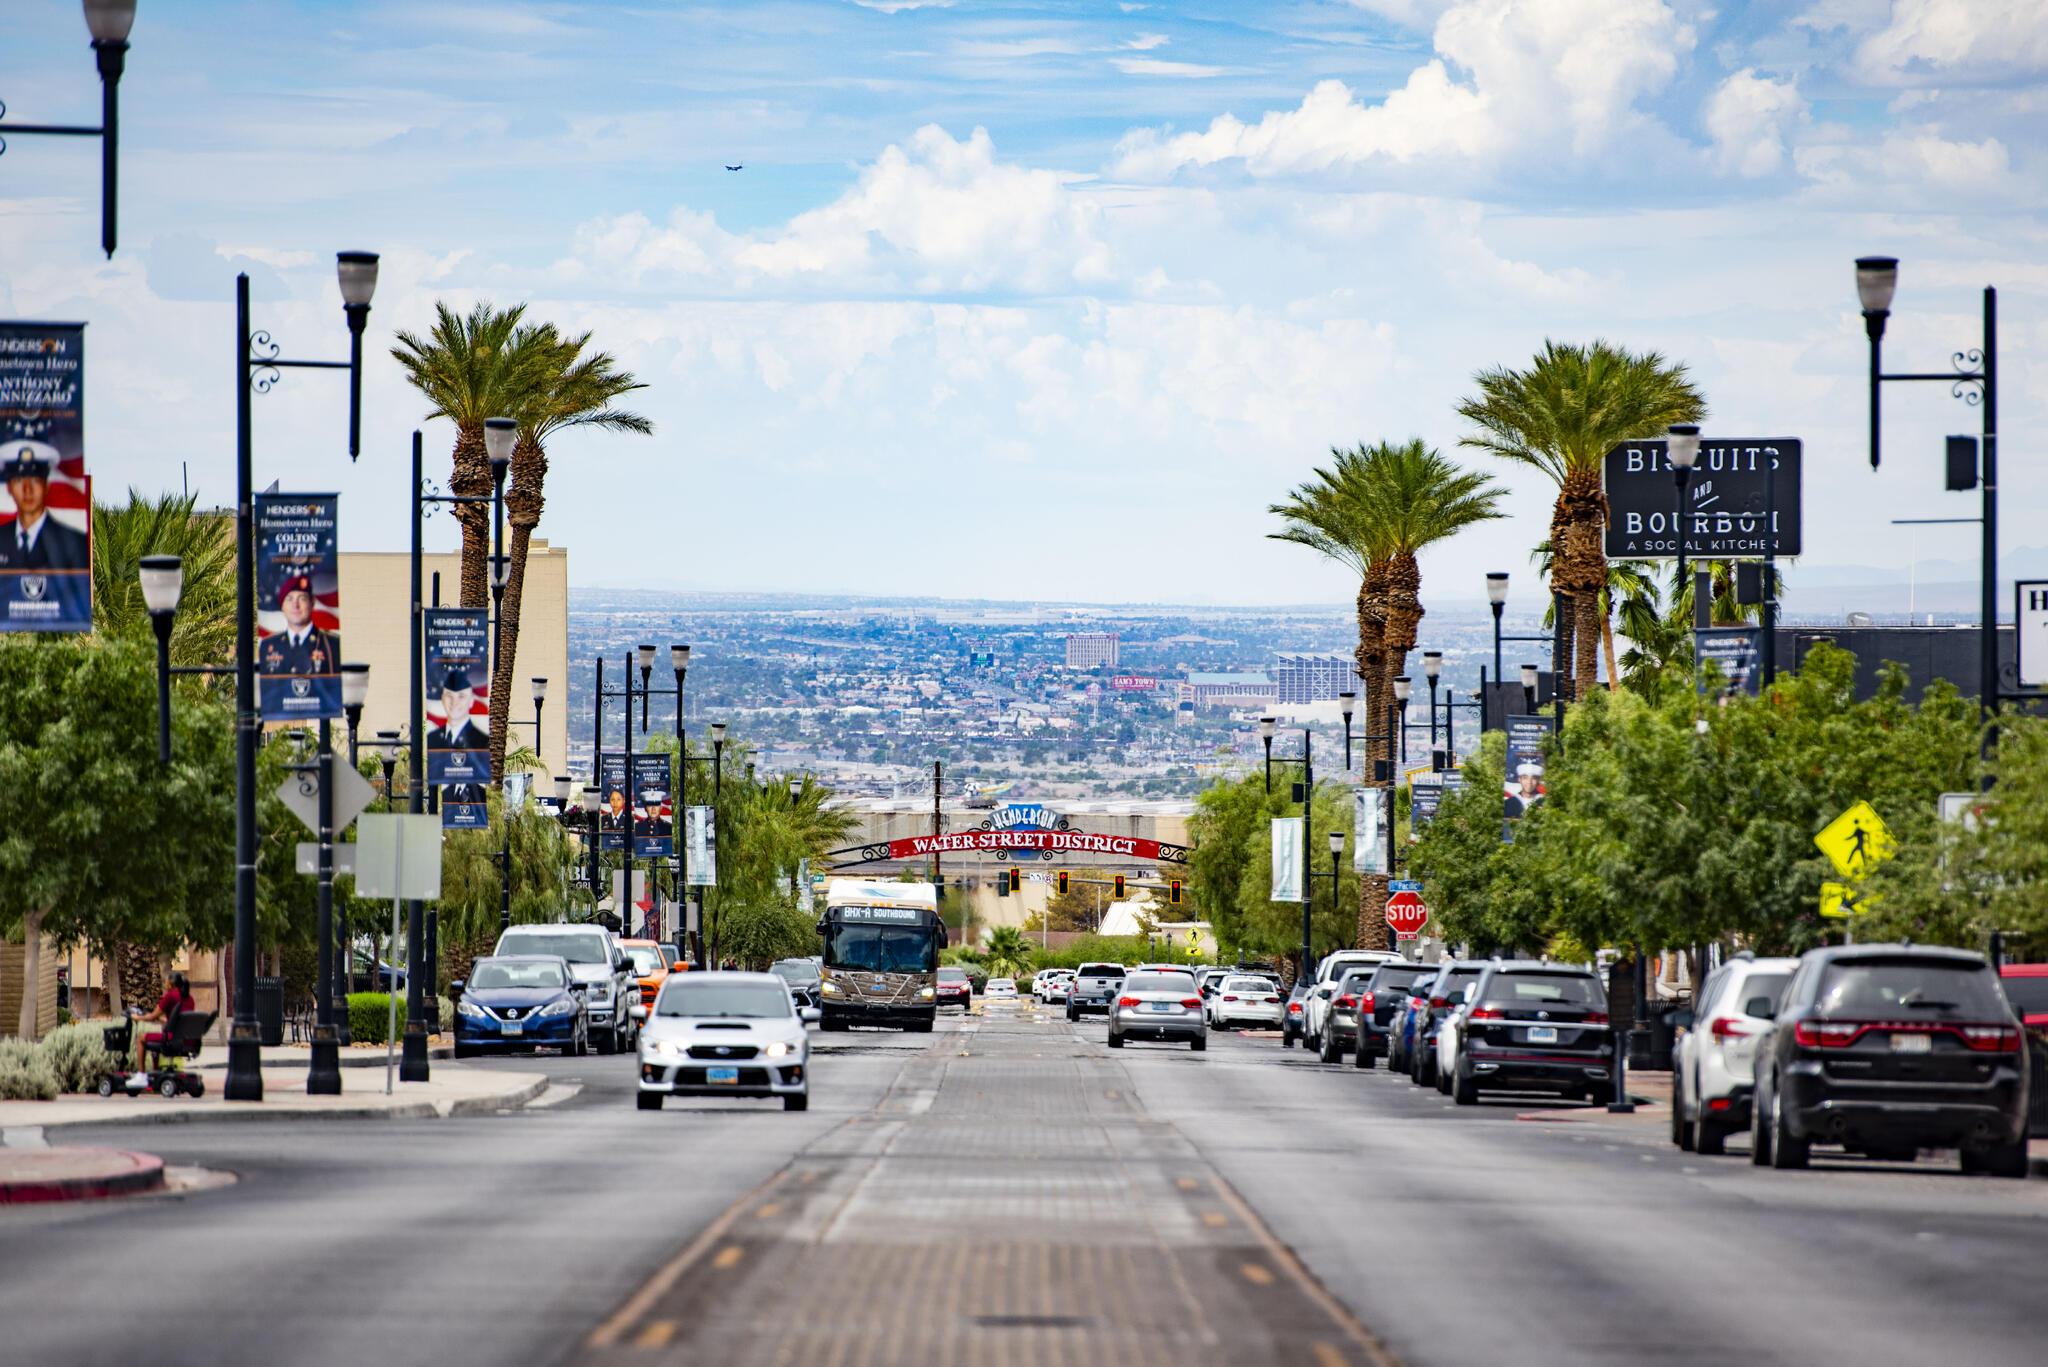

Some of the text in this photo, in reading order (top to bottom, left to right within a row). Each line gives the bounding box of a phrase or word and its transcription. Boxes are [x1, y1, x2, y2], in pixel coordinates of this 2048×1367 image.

[0, 338, 66, 352] NDERSON
[0, 356, 78, 369] metown Hero
[0, 377, 63, 390] NTHONY
[0, 391, 72, 403] NNIZZARO
[1692, 480, 1713, 500] AND
[266, 504, 325, 515] HENDERSON
[260, 517, 334, 528] Hometown Hero
[275, 533, 318, 544] COLTON
[278, 543, 317, 553] LITTLE
[1627, 541, 1637, 550] A
[1645, 540, 1702, 551] SOCAL
[433, 617, 479, 627] HENDERSON
[428, 628, 485, 636] Hometown Hero
[438, 639, 475, 648] BRAYDEN
[442, 647, 471, 655] SPARKS
[992, 807, 1057, 830] HENDERSON
[913, 831, 1137, 854] WATER STREET DISTRICT
[575, 881, 605, 889] GRIE
[873, 908, 916, 919] SOUTHBOUND
[1388, 904, 1426, 920] STOP
